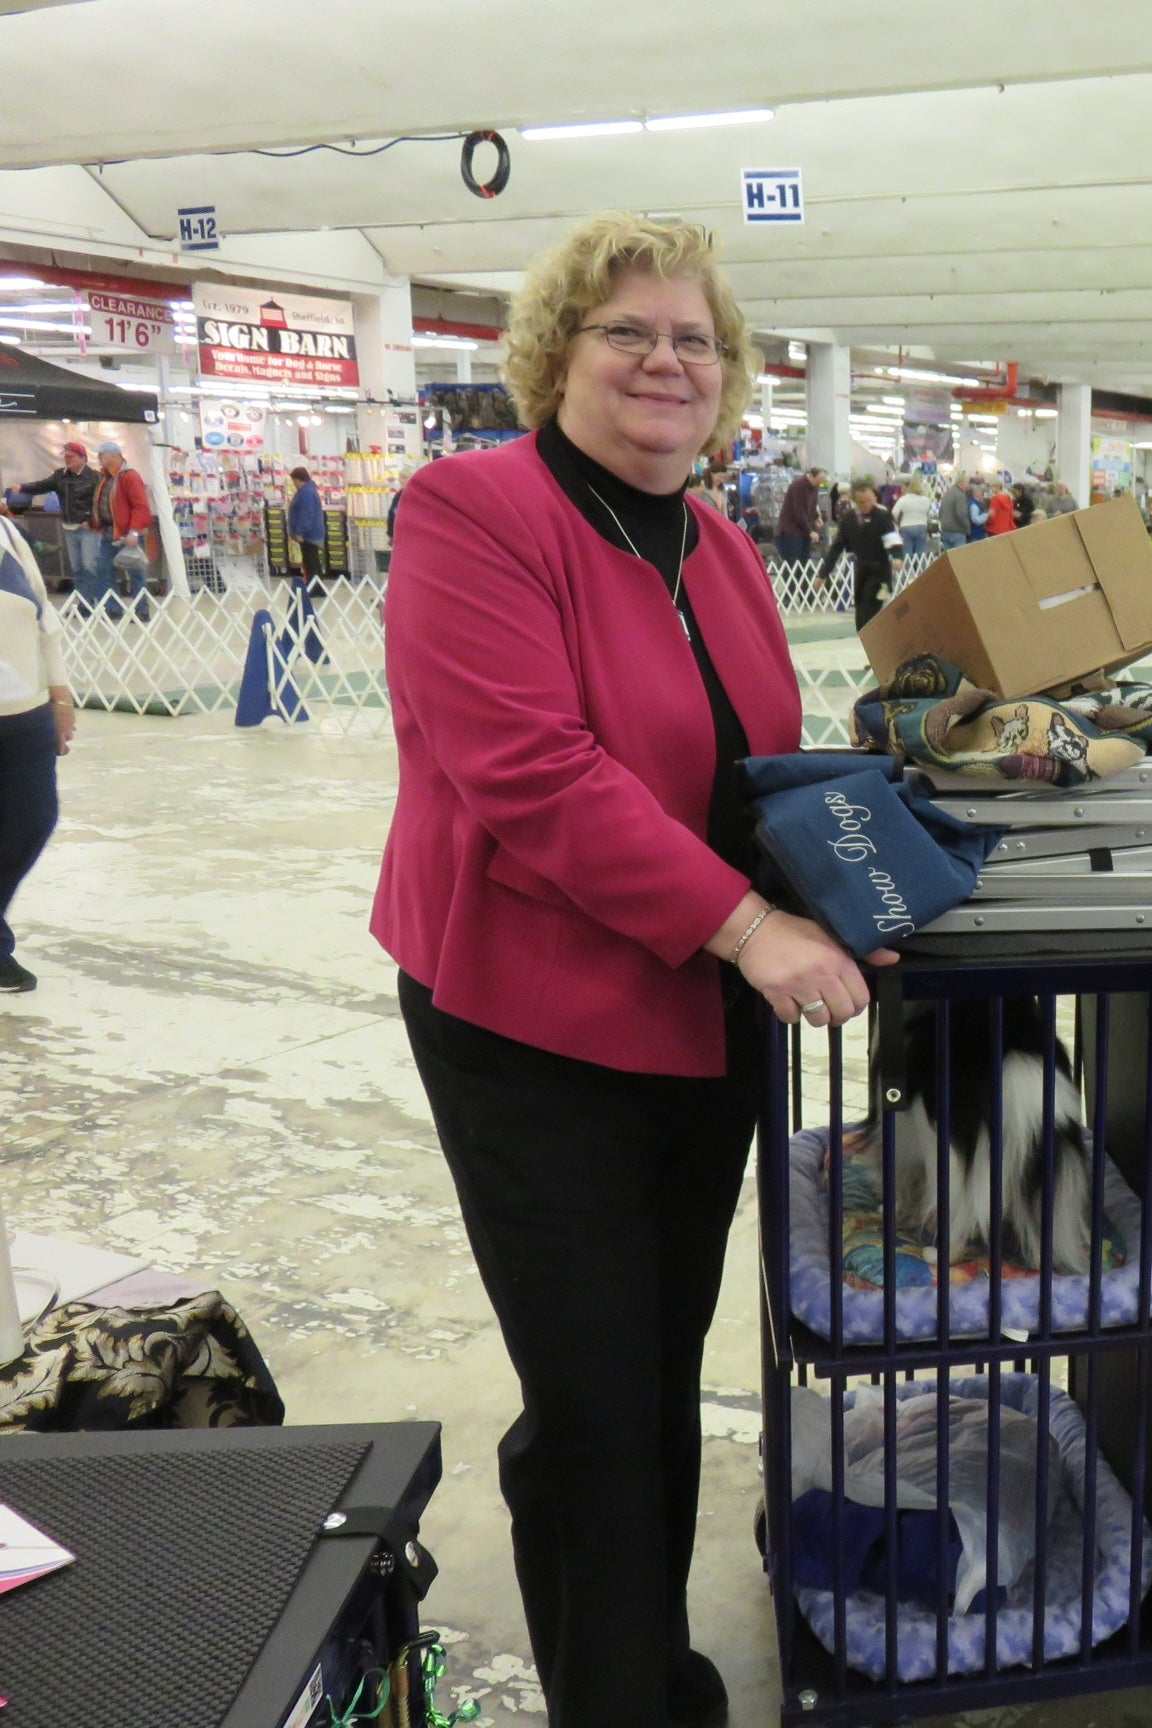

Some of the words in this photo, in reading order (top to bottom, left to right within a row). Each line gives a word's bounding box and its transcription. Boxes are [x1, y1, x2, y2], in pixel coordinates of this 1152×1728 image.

[746, 182, 800, 208] H-11
[180, 218, 217, 241] H-12
[91, 295, 173, 321] CLEARANCE
[225, 303, 249, 314] 1979
[203, 320, 269, 351] SIGN
[279, 329, 350, 359] BARN
[252, 364, 292, 378] Magnets
[295, 369, 312, 380] and
[314, 371, 342, 383] Signs
[267, 355, 284, 366] for
[285, 357, 305, 370] Dog
[824, 791, 877, 862] Dogs
[867, 866, 915, 938] Show
